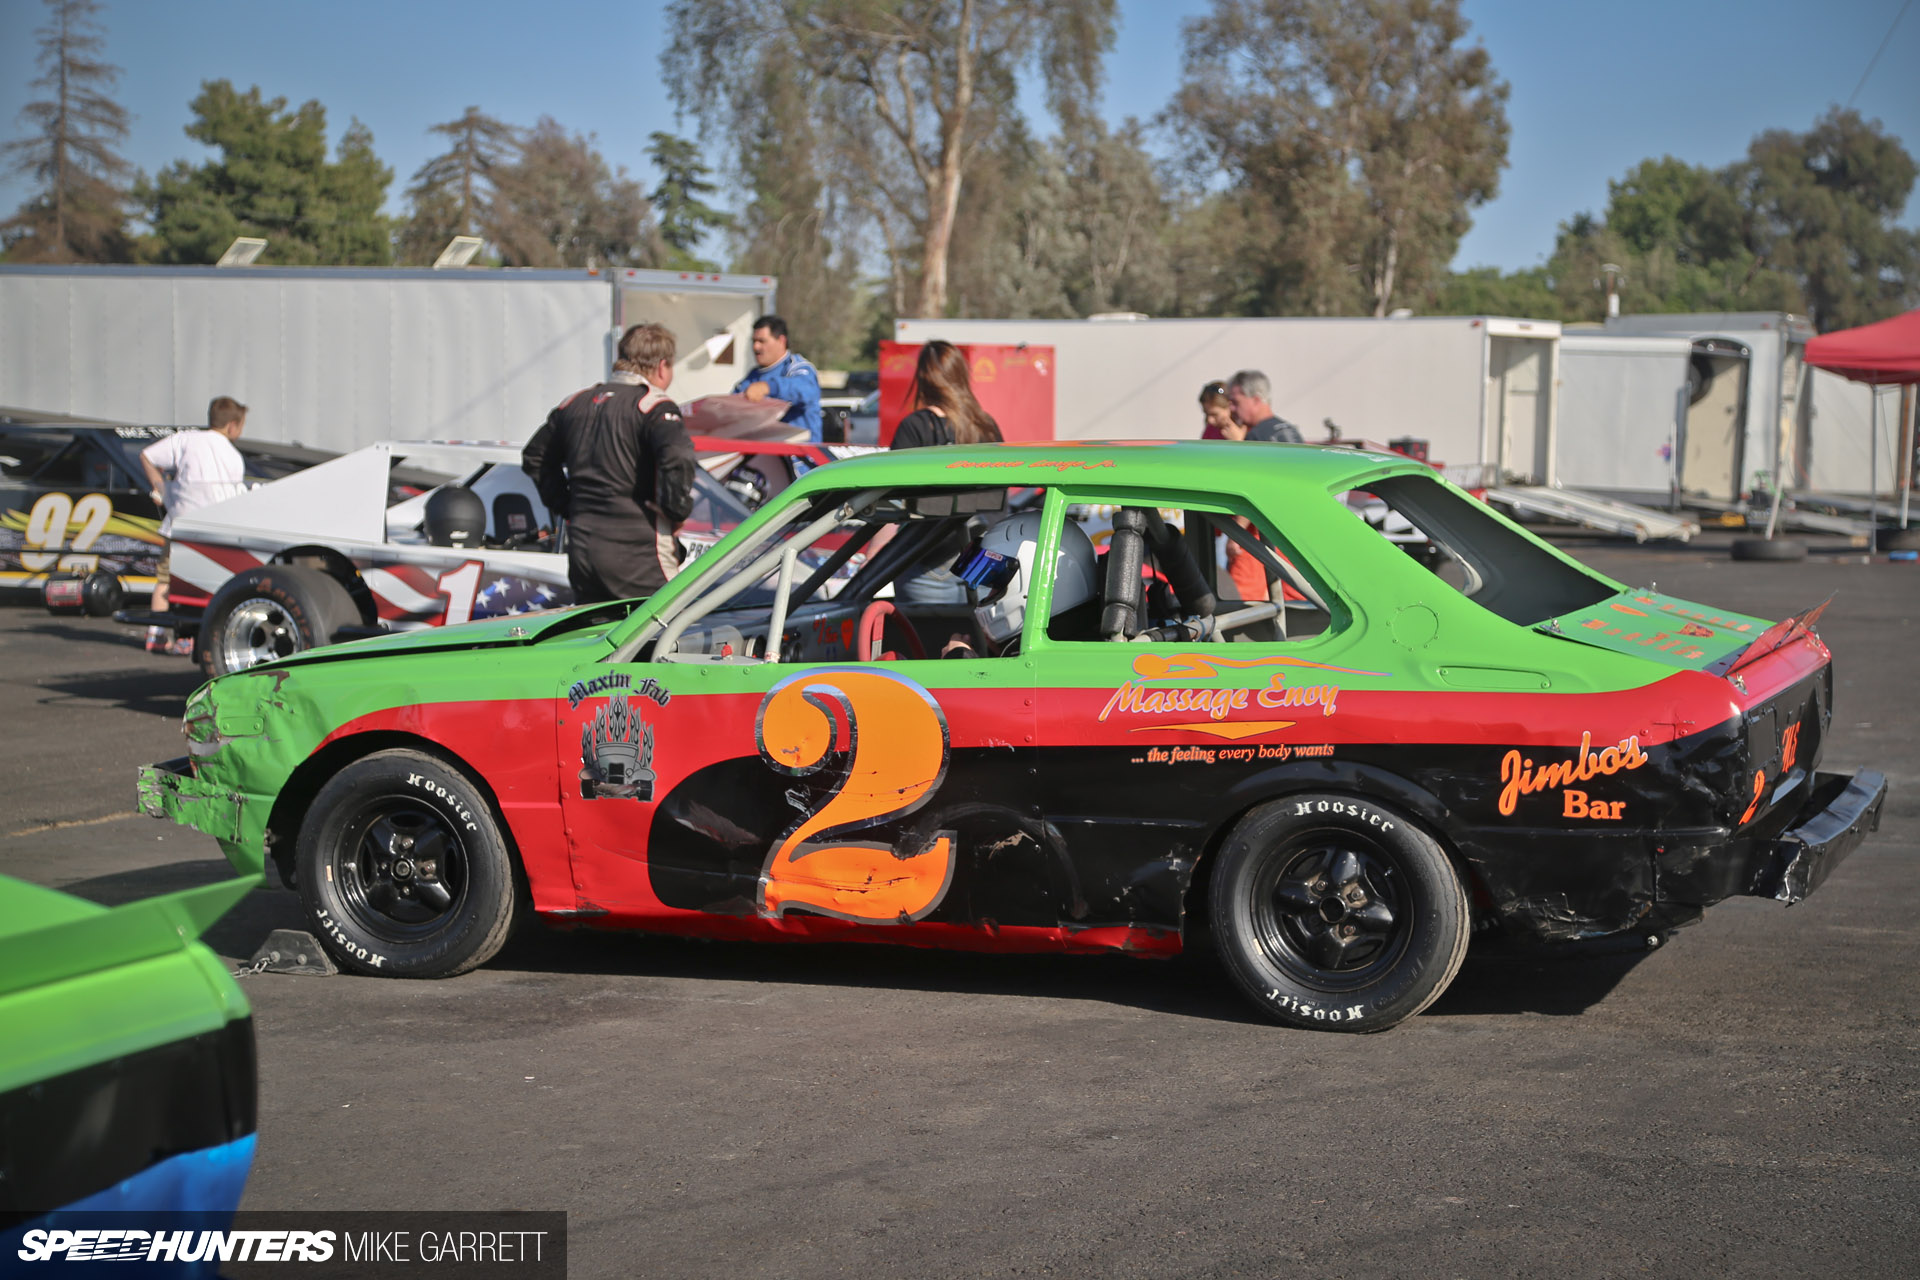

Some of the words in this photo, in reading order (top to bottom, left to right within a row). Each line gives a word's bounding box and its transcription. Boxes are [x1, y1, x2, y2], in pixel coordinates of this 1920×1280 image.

[20, 491, 113, 573] 92
[437, 560, 484, 627] 1
[568, 669, 631, 711] Maxim
[633, 677, 671, 708] Fab
[1098, 680, 1249, 722] Massage
[1257, 672, 1340, 718] Envy
[1147, 747, 1169, 762] the
[1169, 746, 1216, 765] feeling
[1218, 748, 1255, 761] every
[1258, 744, 1291, 761] body
[1294, 744, 1335, 758] wants
[1498, 730, 1649, 817] Jimbo's
[406, 771, 478, 832] Hoosier
[755, 665, 958, 926] 2
[1293, 800, 1395, 833] Hoosier
[1562, 789, 1627, 820] Bar
[316, 908, 388, 968] Hoosier
[1266, 988, 1365, 1022] Hoosier
